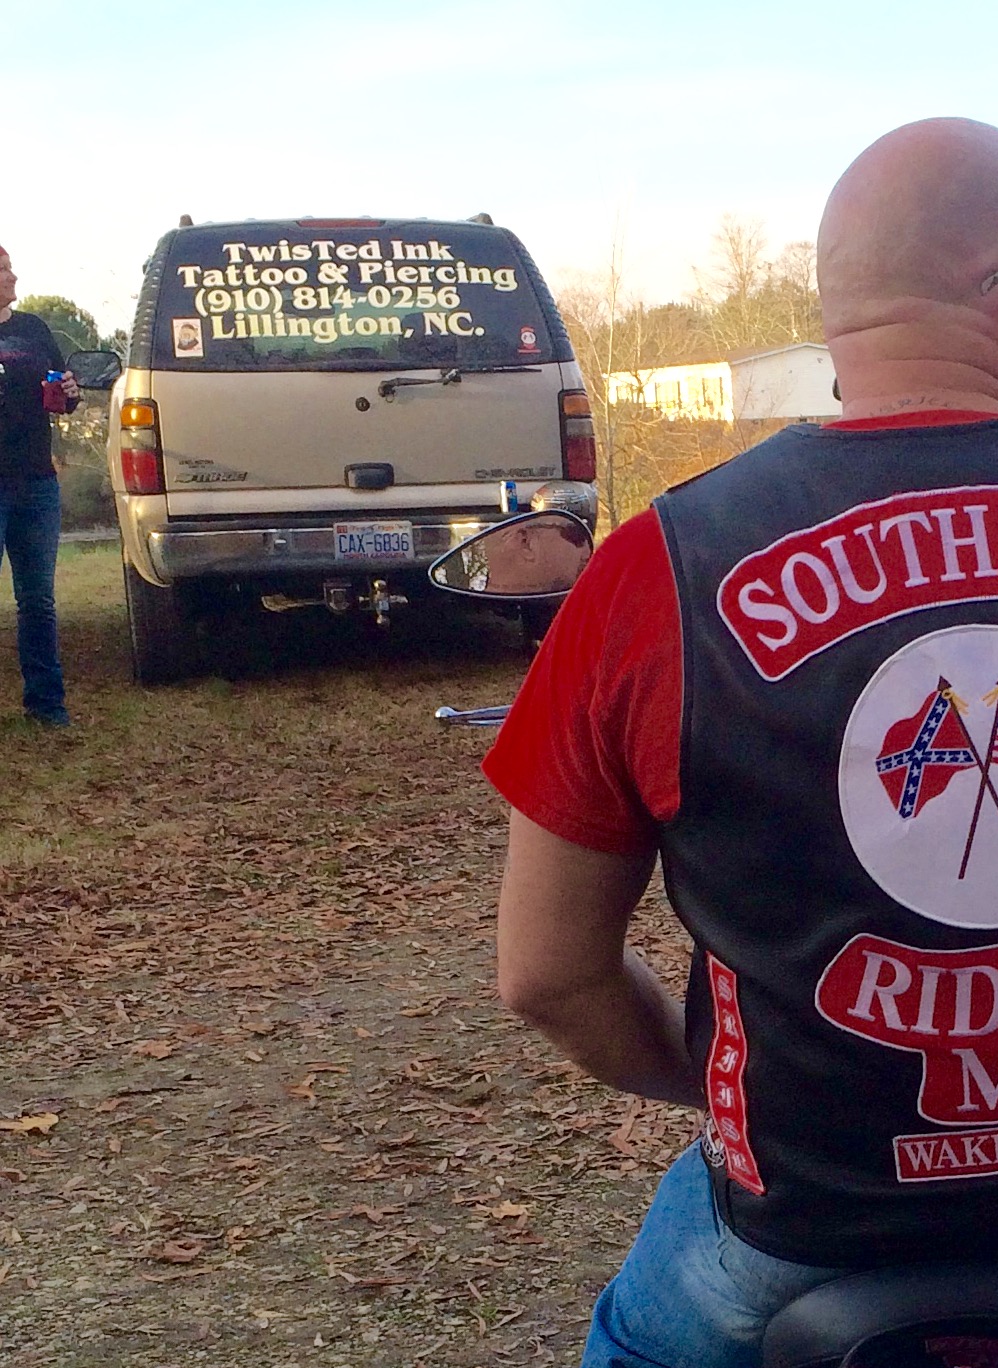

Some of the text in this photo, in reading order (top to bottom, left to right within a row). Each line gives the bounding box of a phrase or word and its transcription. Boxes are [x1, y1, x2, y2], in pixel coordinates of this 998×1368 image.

[222, 239, 455, 263] TwisTed Ink
[177, 260, 518, 291] Tattoo & Piercing
[195, 286, 461, 317] (910) 814-0256
[211, 312, 485, 343] Lillington, NC.
[339, 532, 410, 553] CAX-6836
